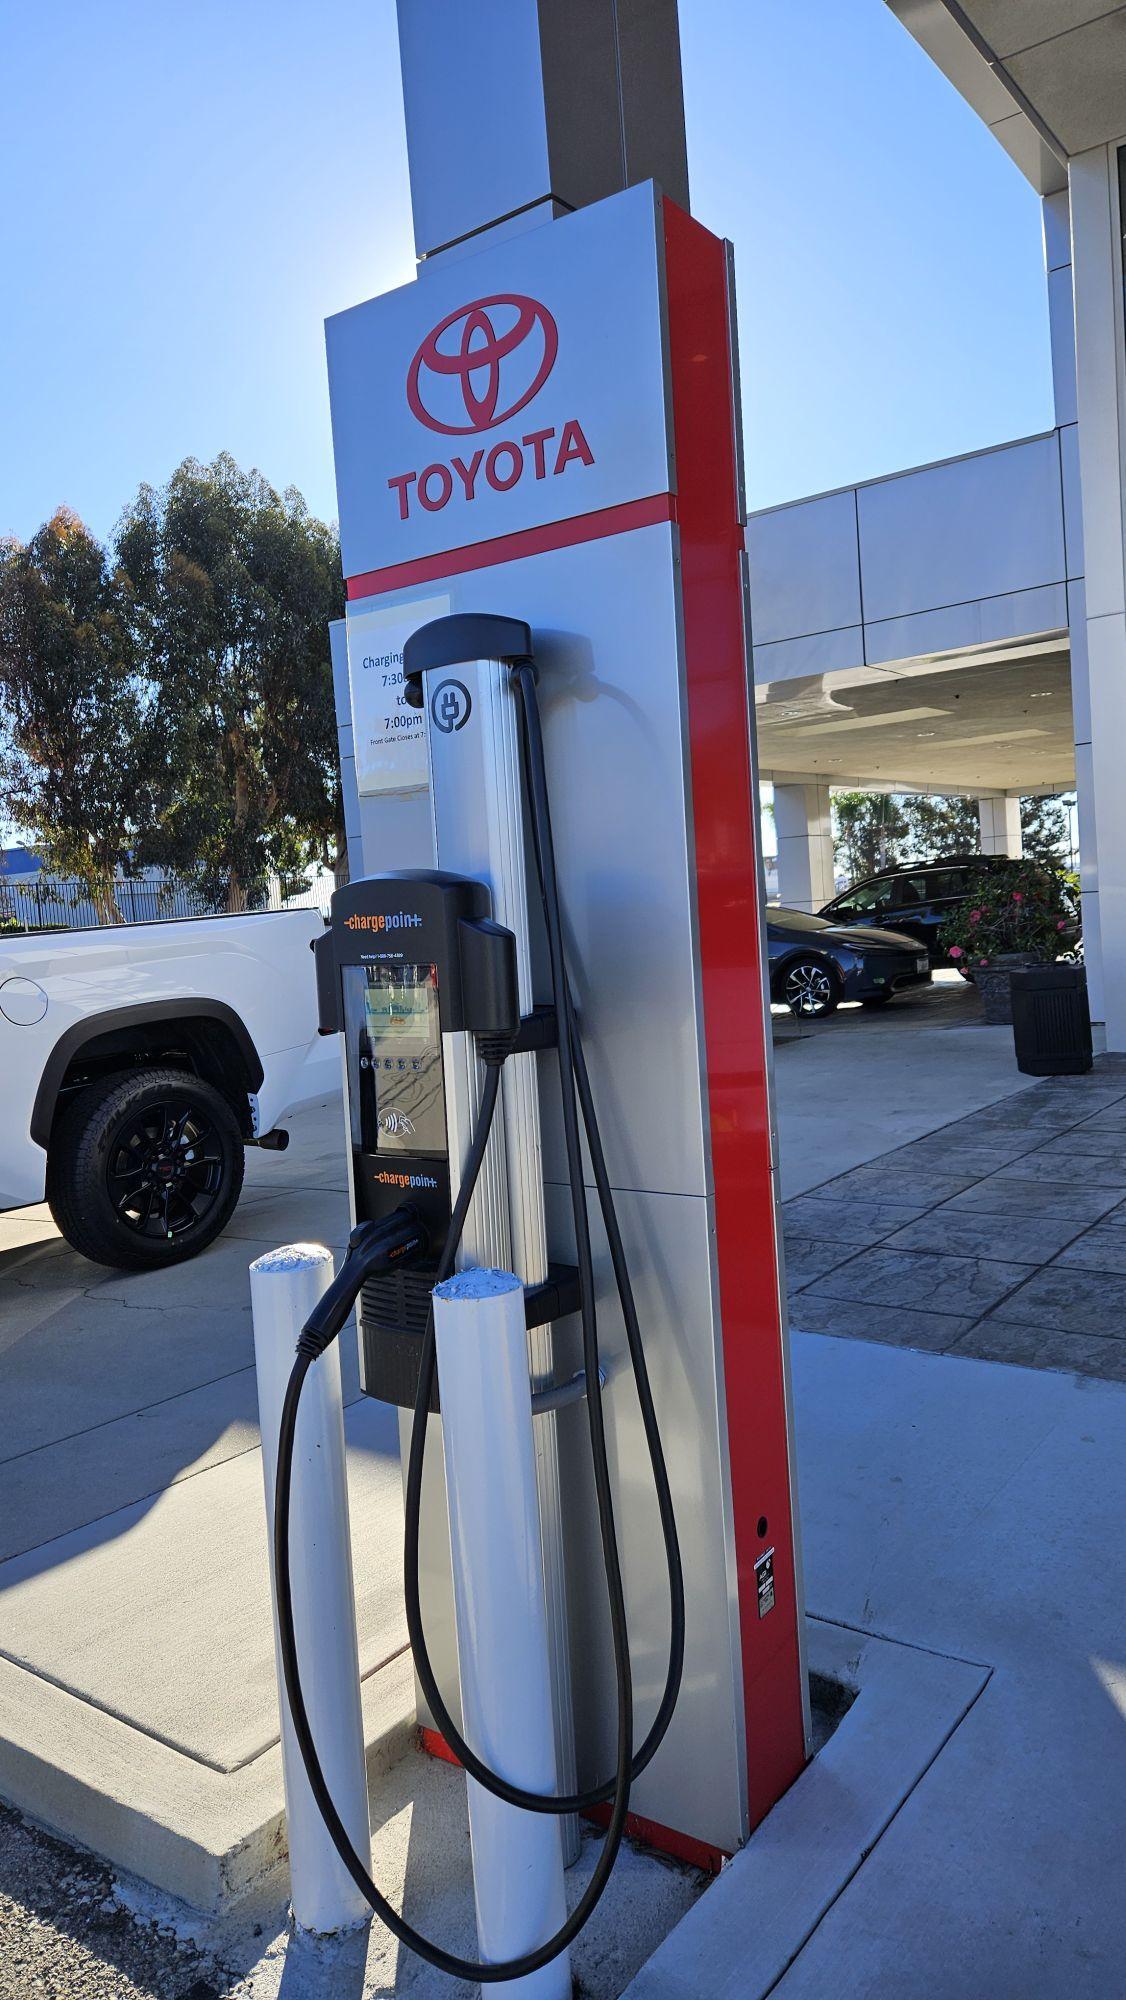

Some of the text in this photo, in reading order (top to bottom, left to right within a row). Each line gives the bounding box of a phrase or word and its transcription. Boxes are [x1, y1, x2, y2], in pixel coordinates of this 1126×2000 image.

[388, 419, 595, 520] TOYOTA
[363, 652, 404, 668] Charging
[382, 672, 407, 686] 7:30
[384, 715, 422, 729] 7:00pm
[384, 736, 395, 744] Gate
[396, 734, 413, 742] Closes
